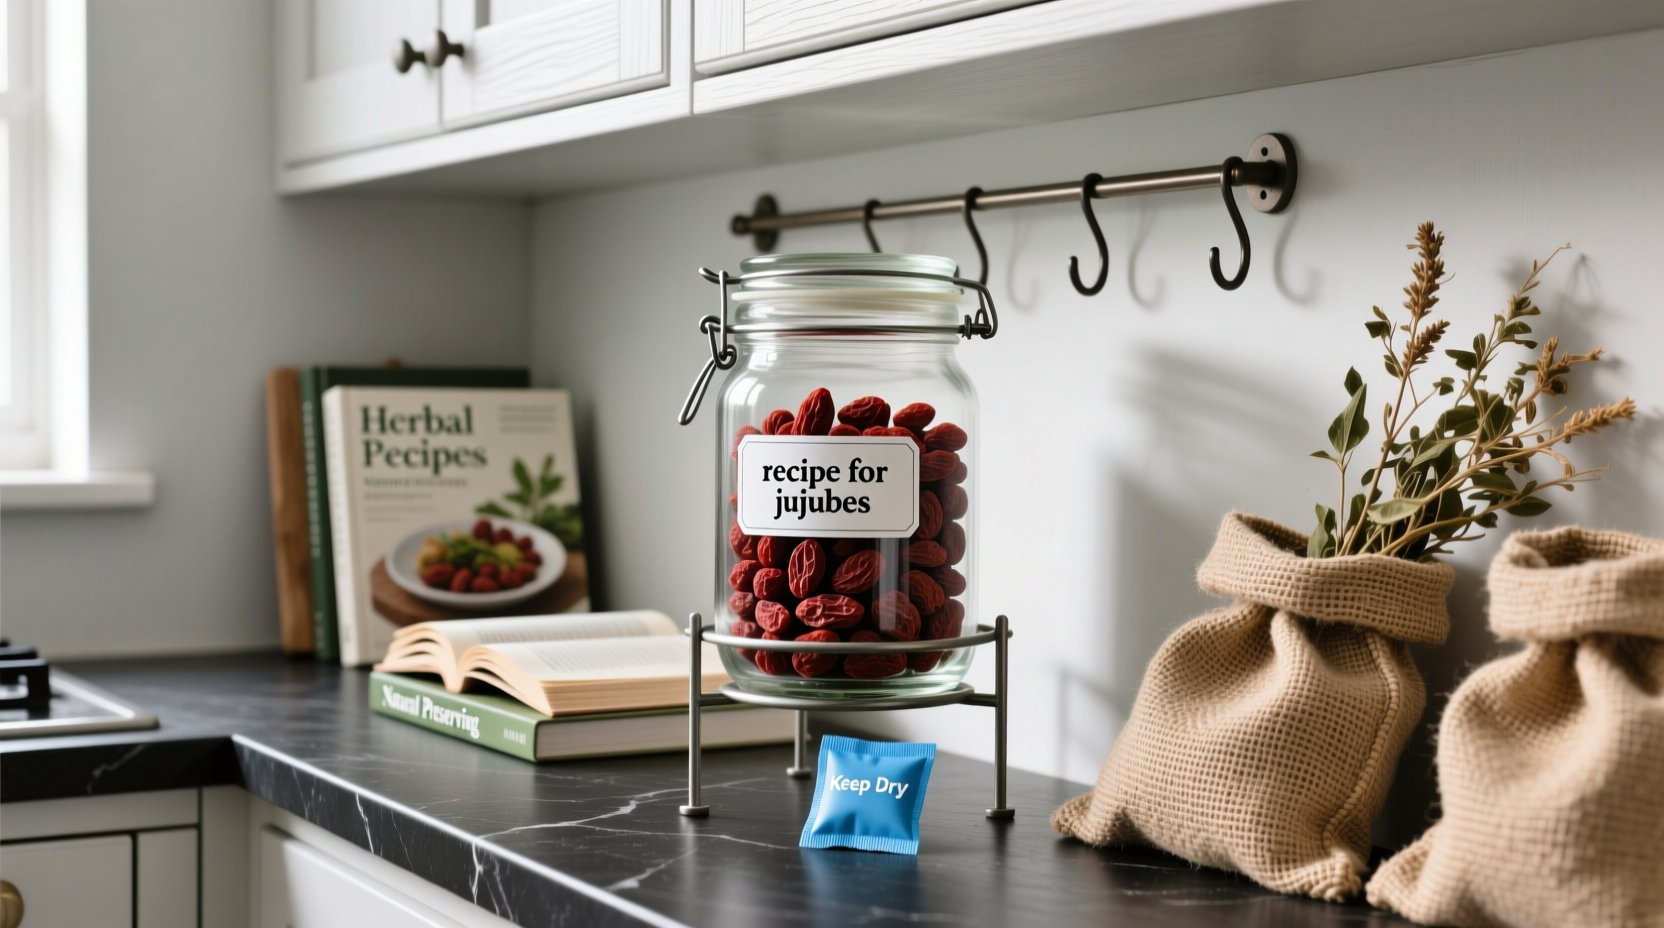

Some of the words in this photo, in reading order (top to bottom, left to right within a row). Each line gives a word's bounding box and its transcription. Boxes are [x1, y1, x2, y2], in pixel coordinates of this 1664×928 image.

[361, 404, 473, 435] Herbal
[762, 458, 840, 489] recipe
[848, 457, 888, 483] for
[773, 488, 871, 520] jujubes
[829, 775, 871, 796] Keep
[875, 776, 909, 799] Dry
